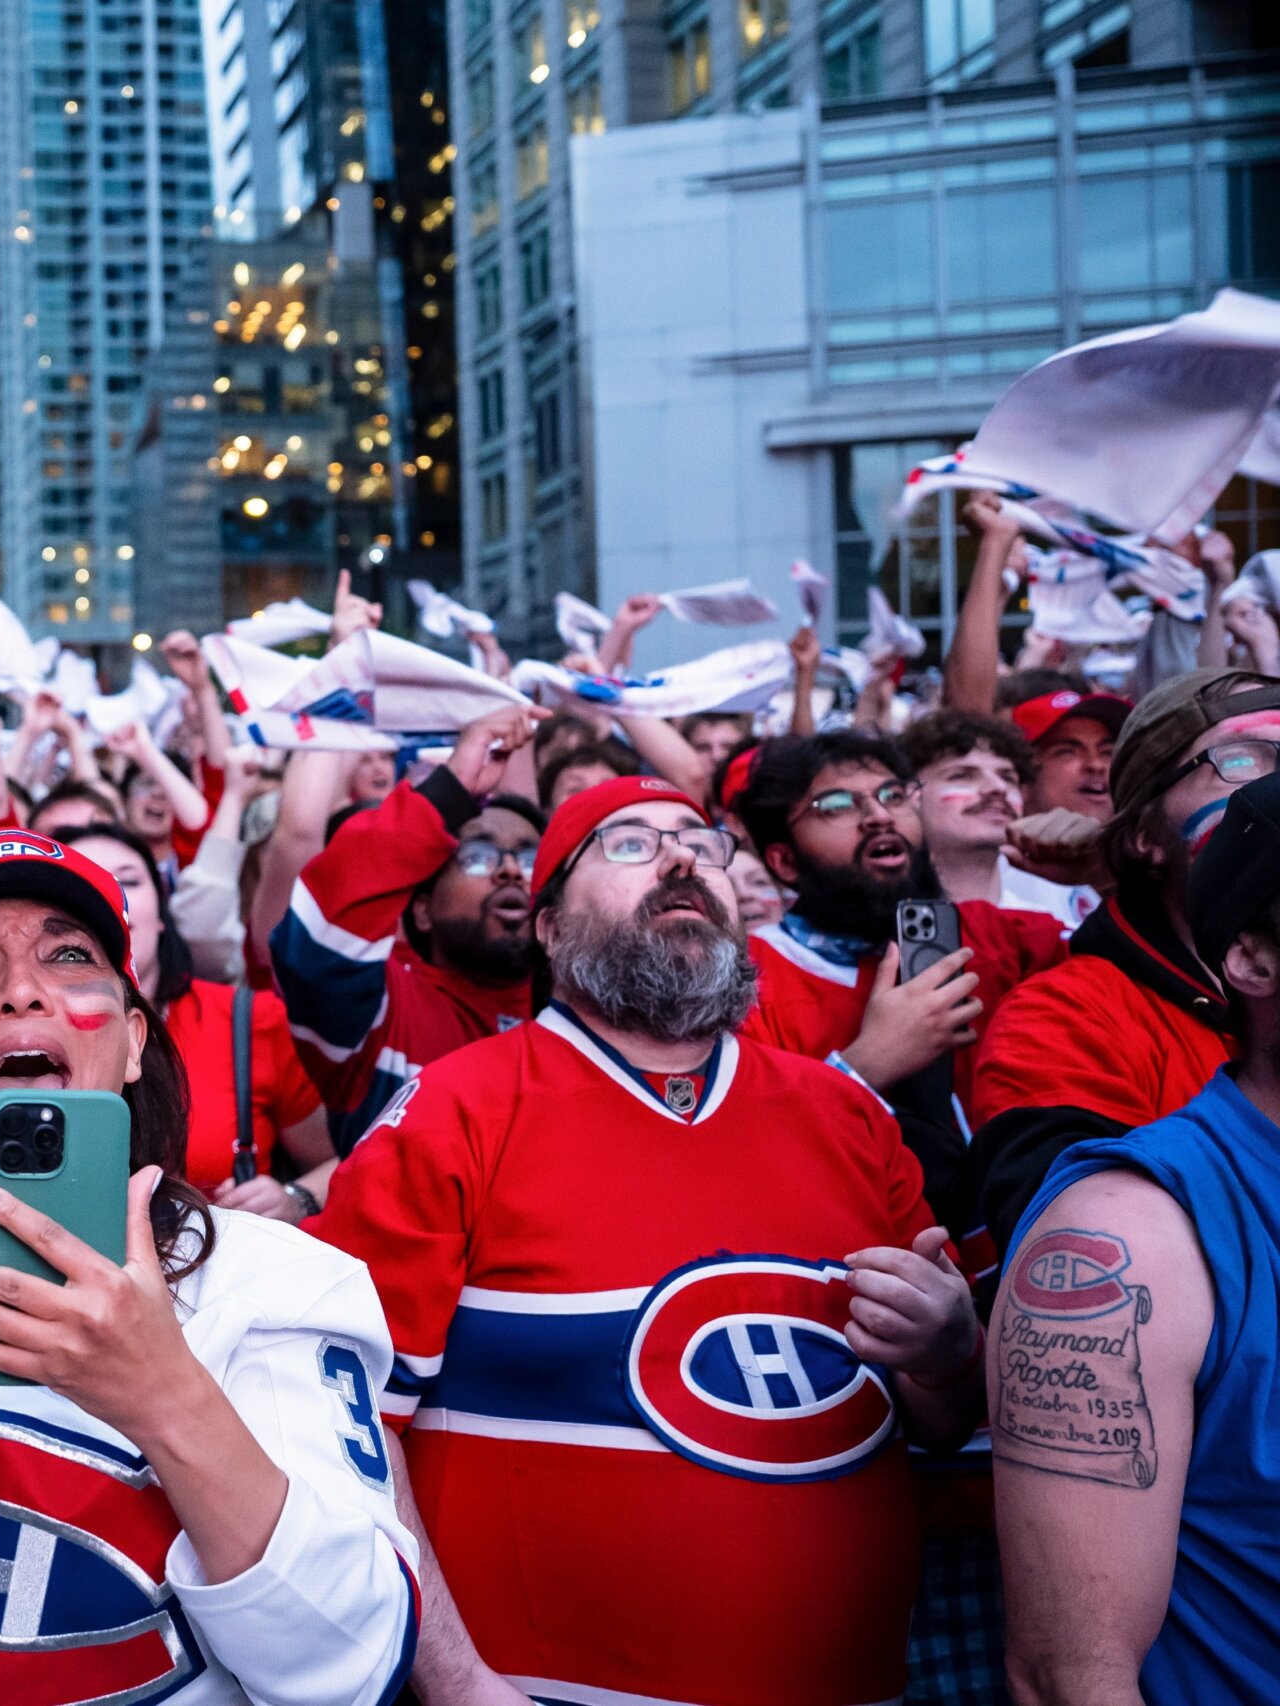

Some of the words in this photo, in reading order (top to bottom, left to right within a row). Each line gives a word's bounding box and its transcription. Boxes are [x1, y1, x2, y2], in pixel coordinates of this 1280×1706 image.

[1002, 1315, 1130, 1358] Raymond
[1000, 1349, 1100, 1392] Rajotte
[1088, 1399, 1135, 1418] 1935
[1020, 1424, 1097, 1445] novembre
[1099, 1427, 1141, 1447] 2019
